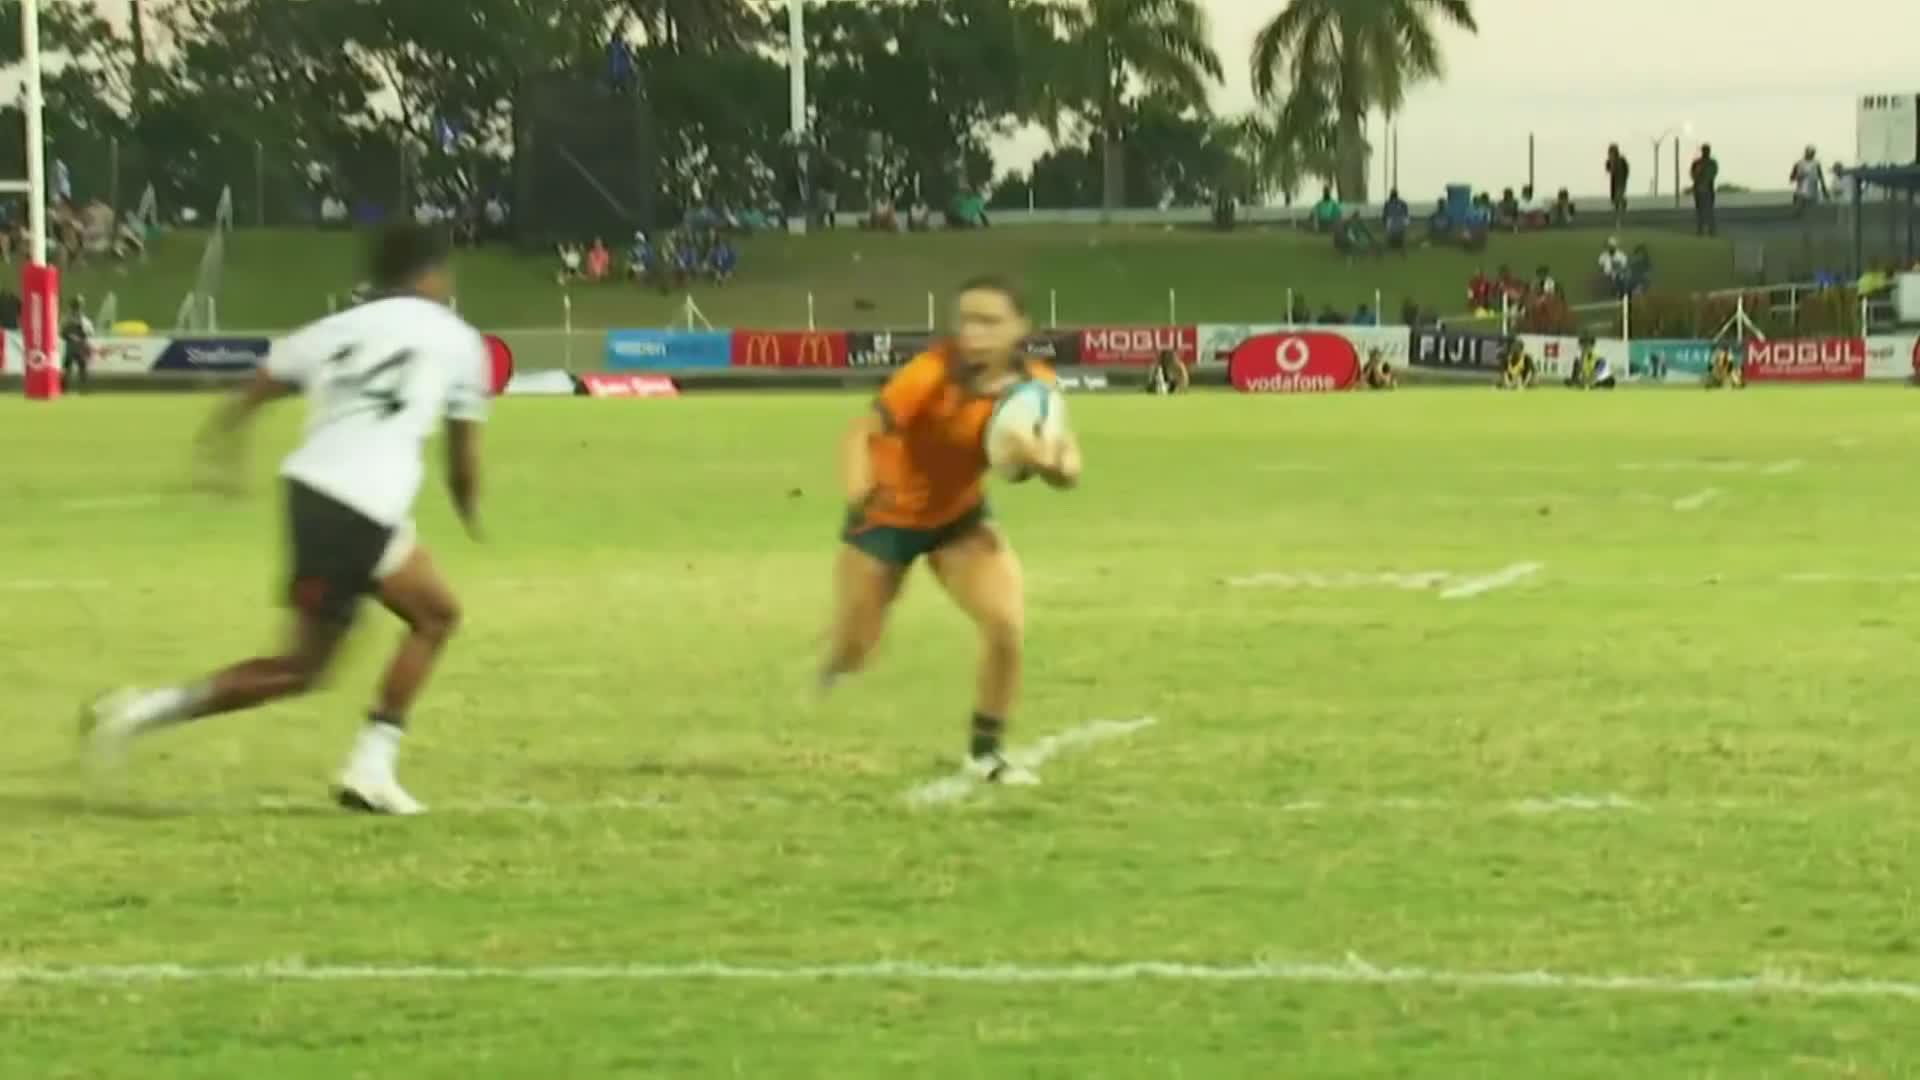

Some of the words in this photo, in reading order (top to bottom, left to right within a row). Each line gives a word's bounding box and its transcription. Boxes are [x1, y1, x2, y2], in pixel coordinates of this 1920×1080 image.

[1084, 329, 1194, 351] MOGUL
[1419, 335, 1477, 364] FIJI
[1747, 342, 1864, 365] MOGUL
[1246, 373, 1336, 393] vodafone
